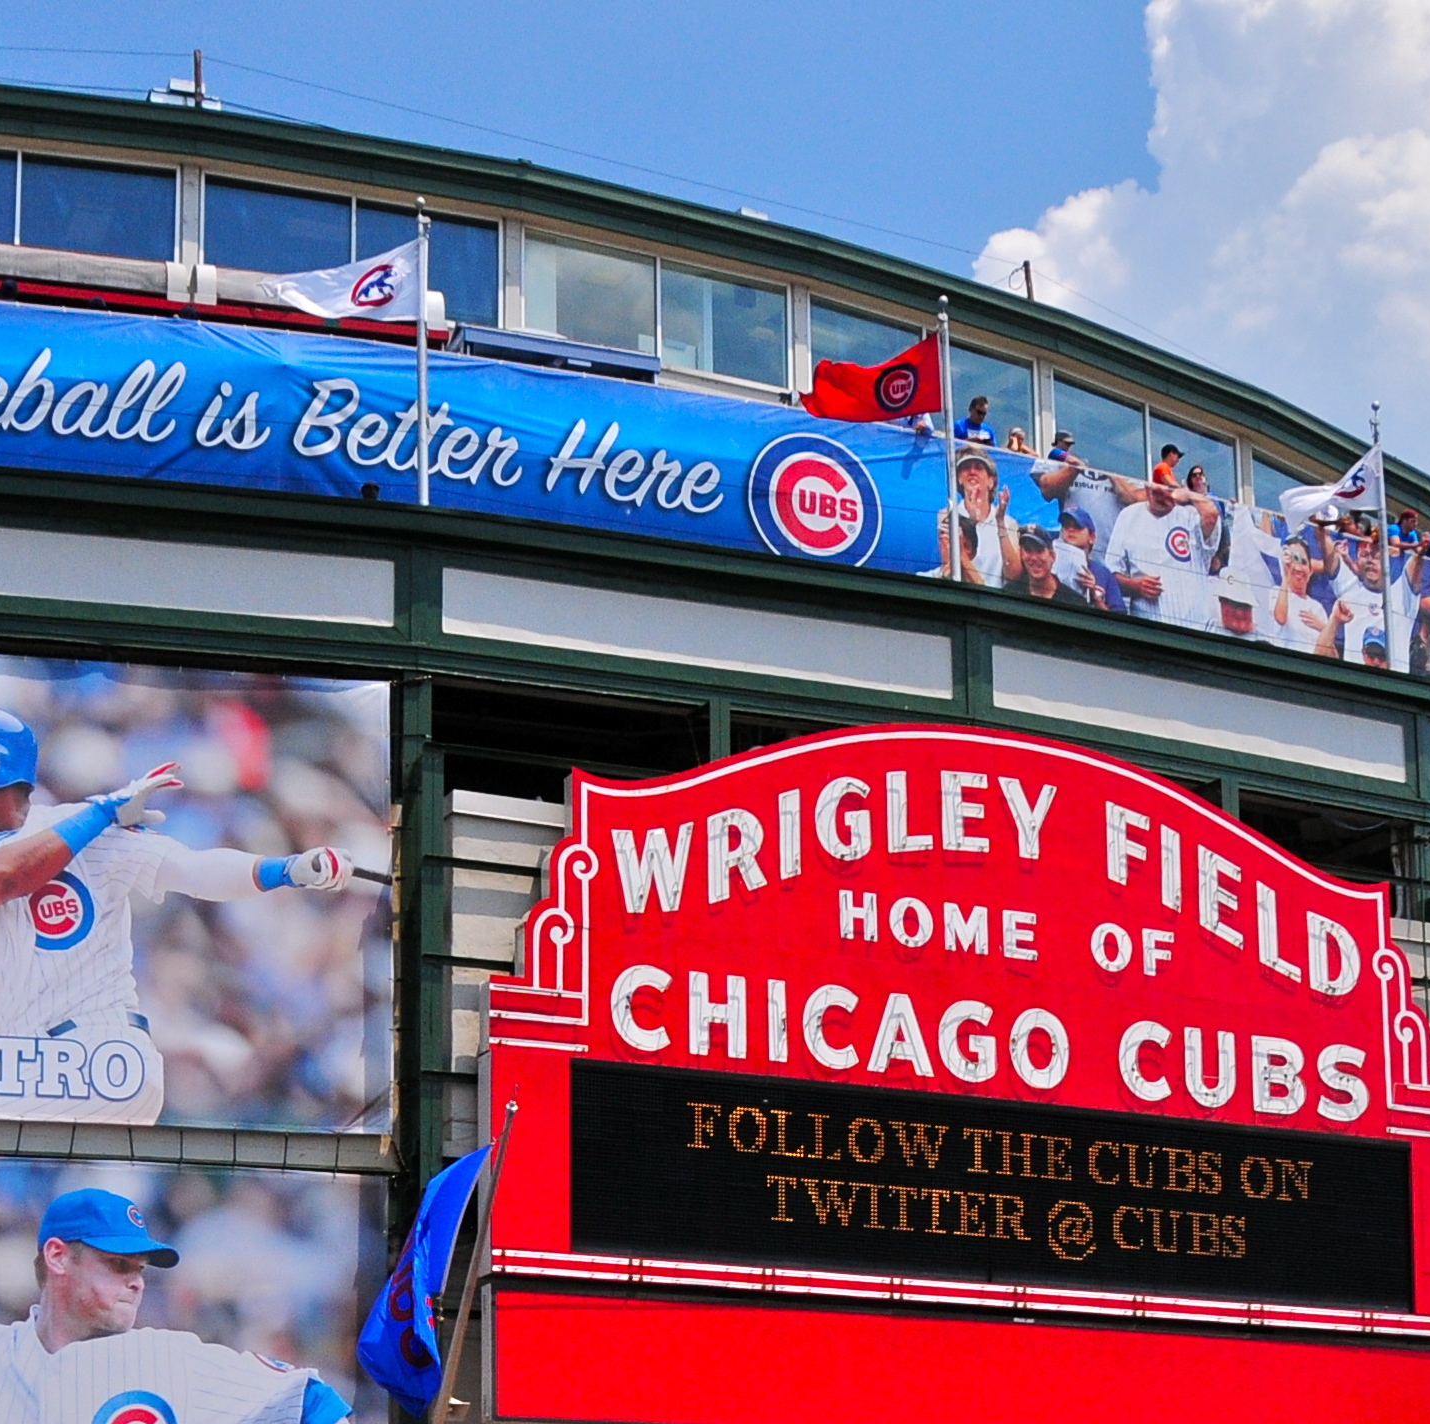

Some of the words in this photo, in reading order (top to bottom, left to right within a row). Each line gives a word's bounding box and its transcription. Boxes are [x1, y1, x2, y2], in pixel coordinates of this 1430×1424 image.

[196, 381, 271, 451] is
[293, 376, 522, 488] Better
[546, 419, 724, 514] Here
[774, 457, 861, 554] CUBS
[610, 768, 1058, 917] WRIGLEY
[1105, 799, 1363, 1000] FIELD
[838, 888, 1039, 963] HOME
[1089, 921, 1175, 978] OF
[609, 964, 1071, 1091] CHICAGO
[1117, 1019, 1371, 1123] CUBS
[685, 1100, 950, 1171] FOLLOW
[961, 1127, 1073, 1184] THE
[1086, 1141, 1224, 1196] CUBS
[1238, 1156, 1314, 1202] ON
[766, 1174, 1031, 1242] TWITTER
[1047, 1199, 1096, 1260] @
[1111, 1206, 1248, 1258] CUBS
